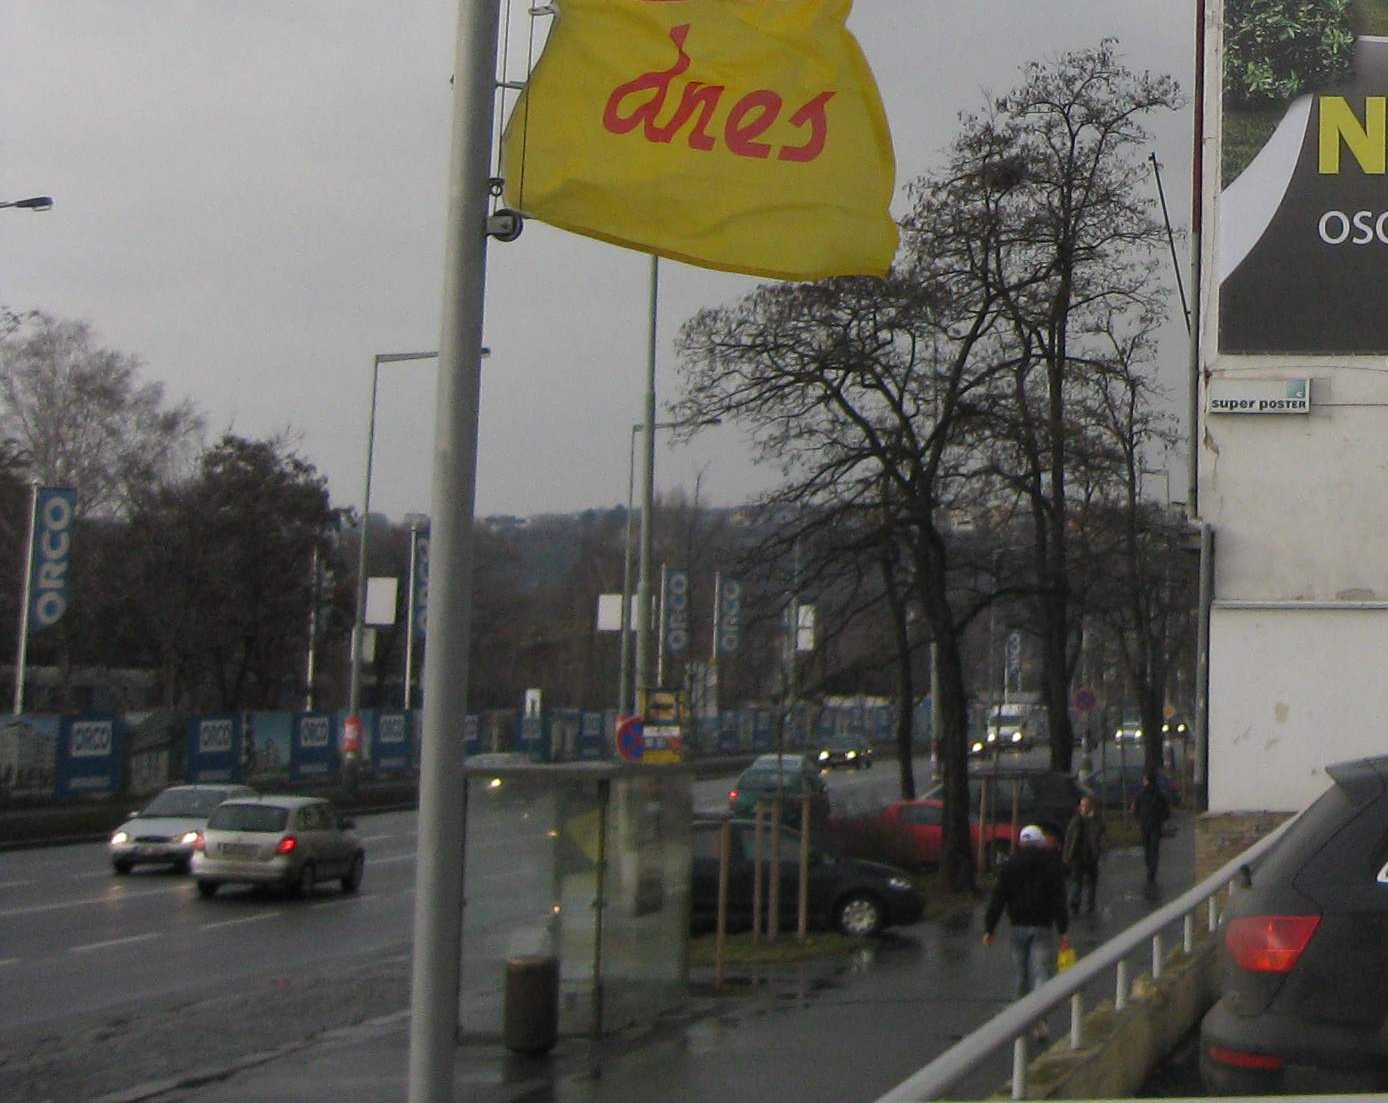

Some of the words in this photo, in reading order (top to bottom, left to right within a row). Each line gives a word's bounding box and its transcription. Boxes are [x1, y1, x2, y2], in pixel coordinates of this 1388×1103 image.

[602, 24, 836, 162] dnes
[1211, 399, 1256, 411] super
[36, 496, 72, 625] ORCO
